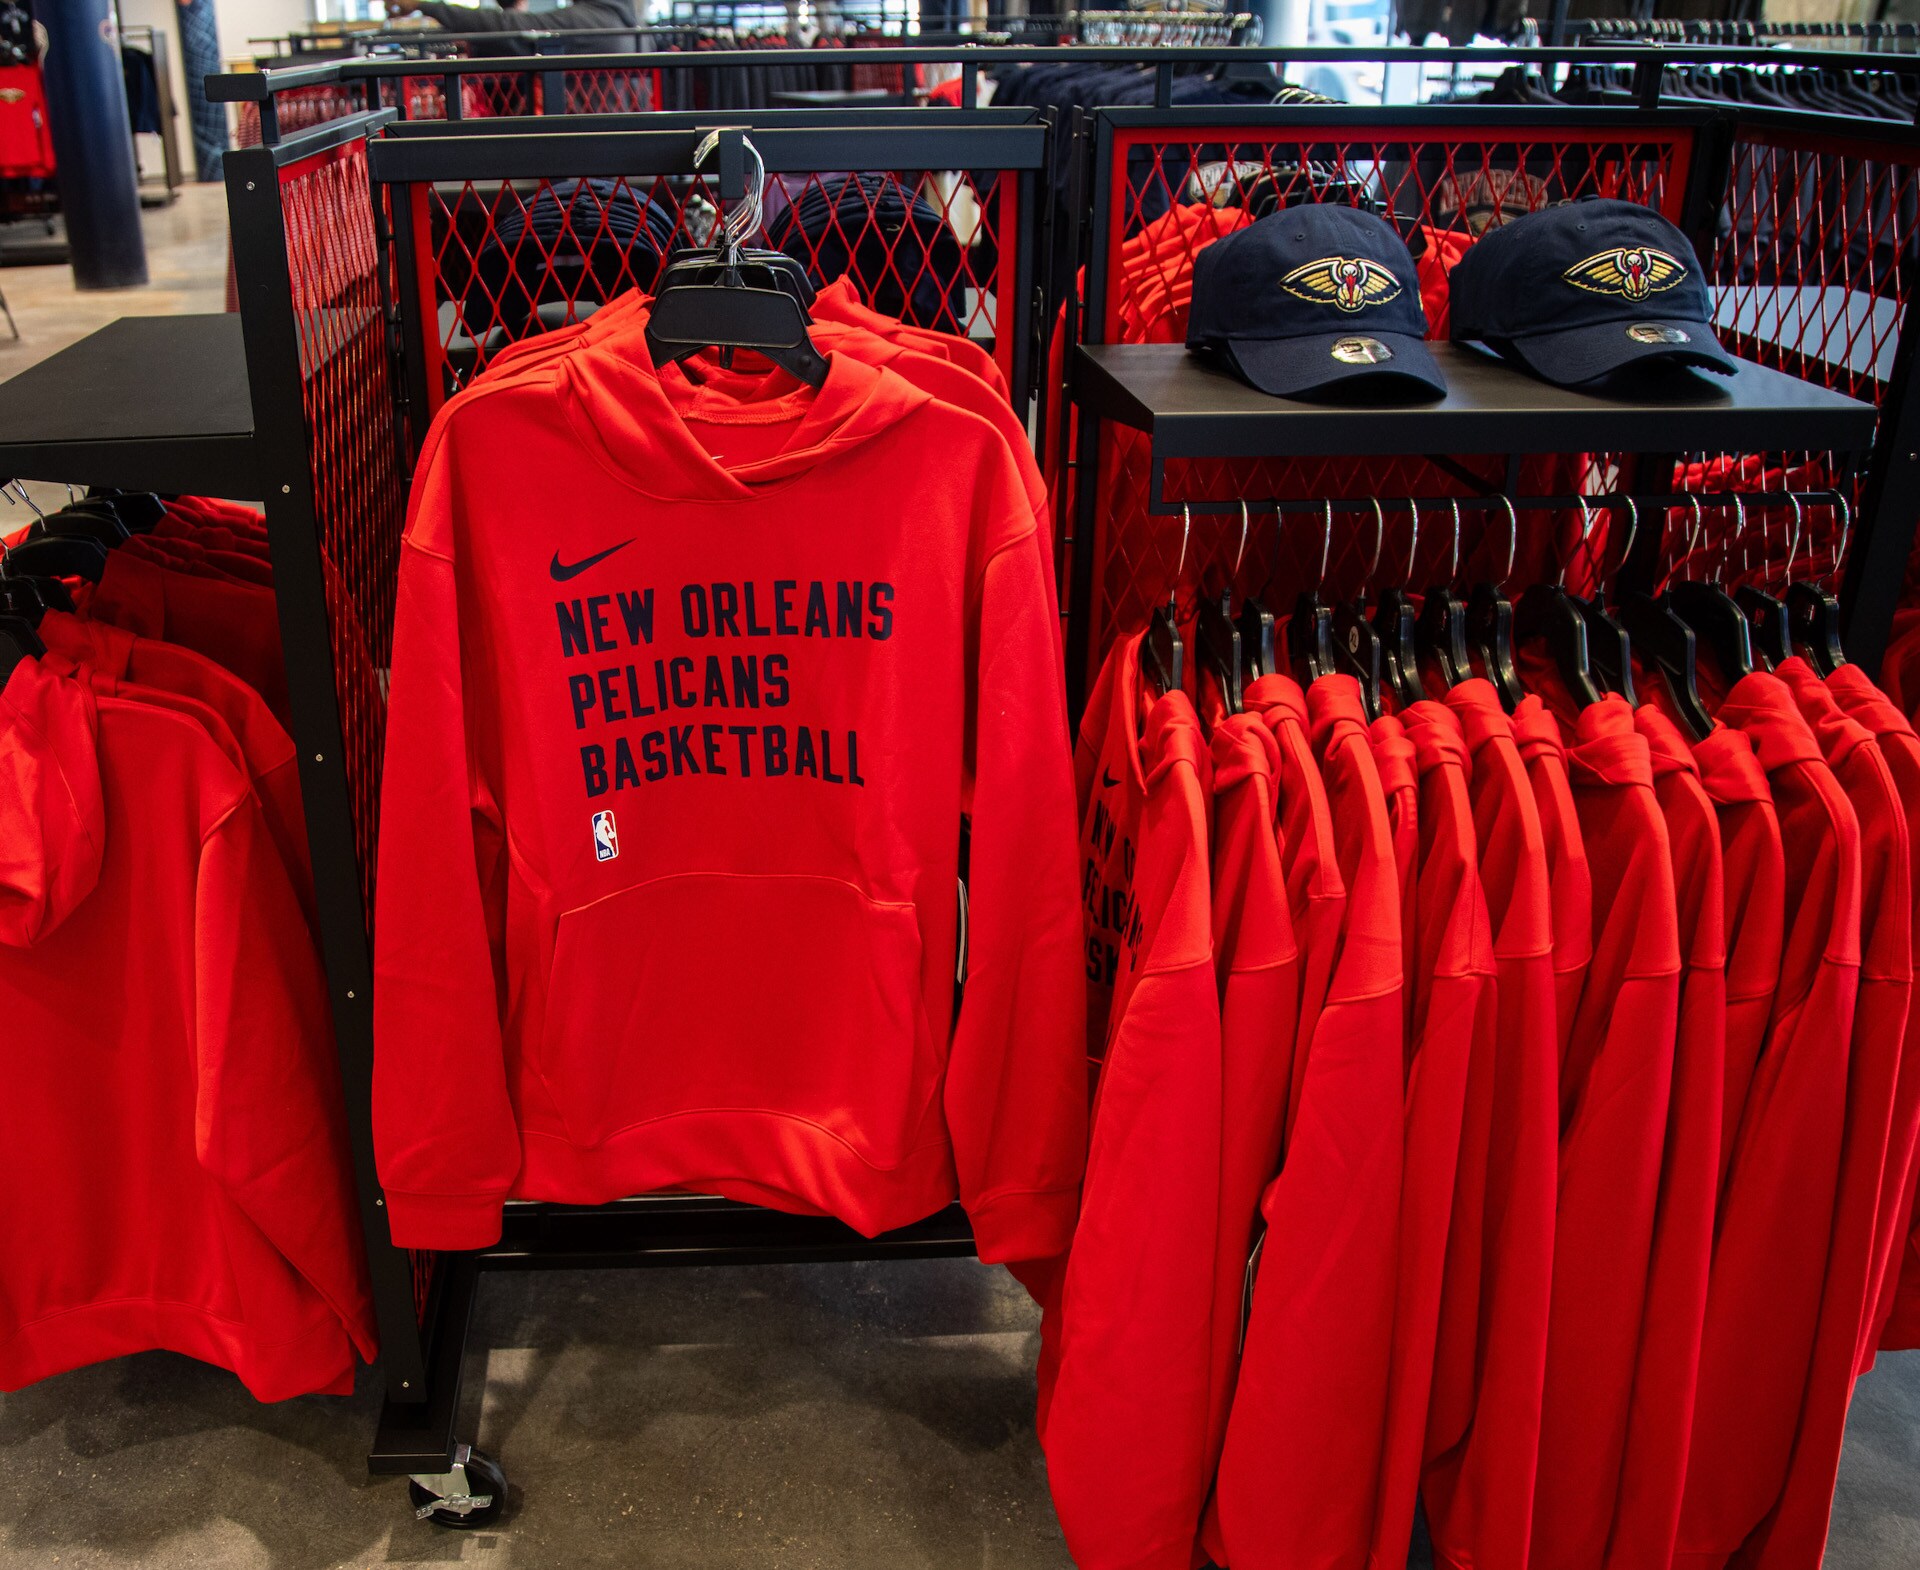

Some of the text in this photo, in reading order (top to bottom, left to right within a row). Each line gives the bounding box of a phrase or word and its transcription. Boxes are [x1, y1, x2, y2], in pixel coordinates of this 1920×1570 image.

[555, 579, 895, 658] NEW ORLEANS
[568, 653, 790, 730] PELICANS
[579, 723, 865, 798] BASKETBALL
[599, 847, 611, 859] NBA
